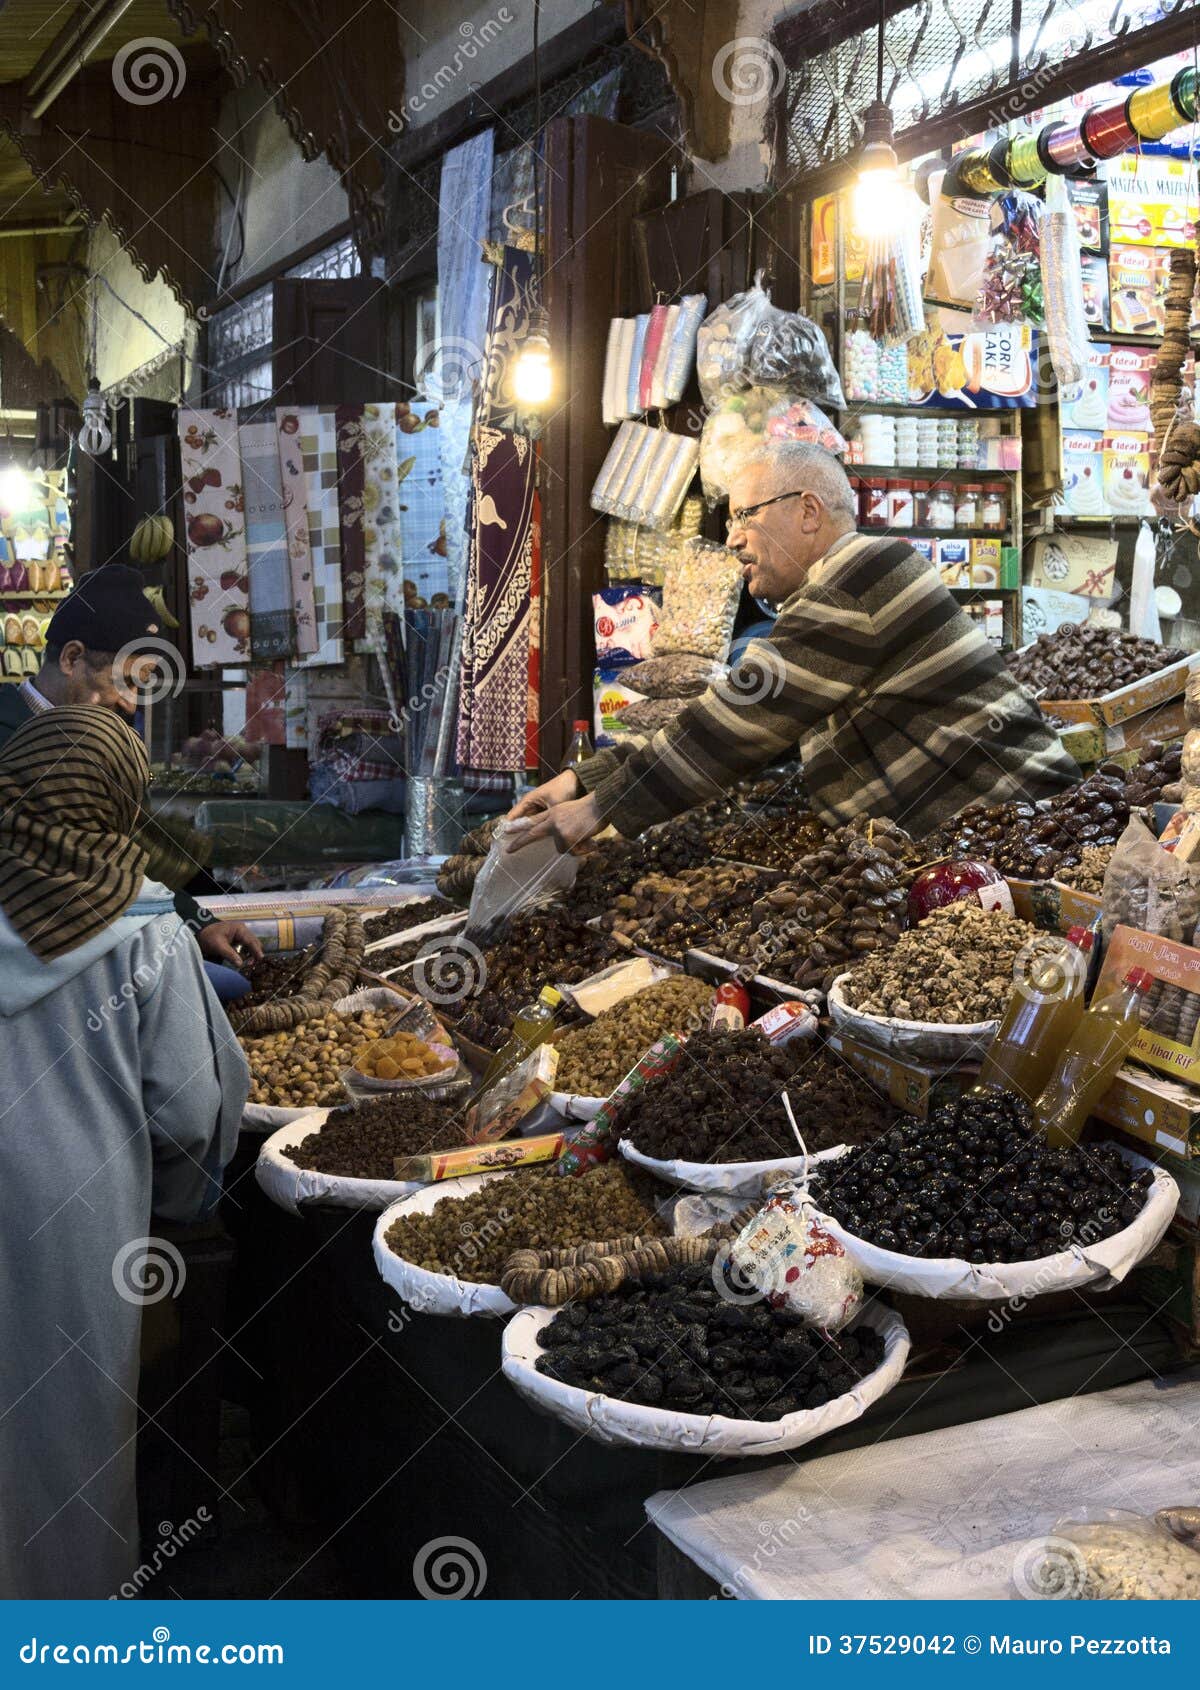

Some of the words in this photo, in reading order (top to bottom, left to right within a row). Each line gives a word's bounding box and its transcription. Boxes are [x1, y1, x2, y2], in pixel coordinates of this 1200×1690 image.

[1123, 257, 1145, 265] Ideal
[985, 331, 997, 373] LAKE
[1115, 357, 1138, 366] Ideal
[1068, 439, 1092, 449] Ideal
[1116, 440, 1139, 451] Ideal
[1135, 1039, 1148, 1050] de
[1150, 1043, 1174, 1061] Jibal
[1175, 1053, 1194, 1069] Rif
